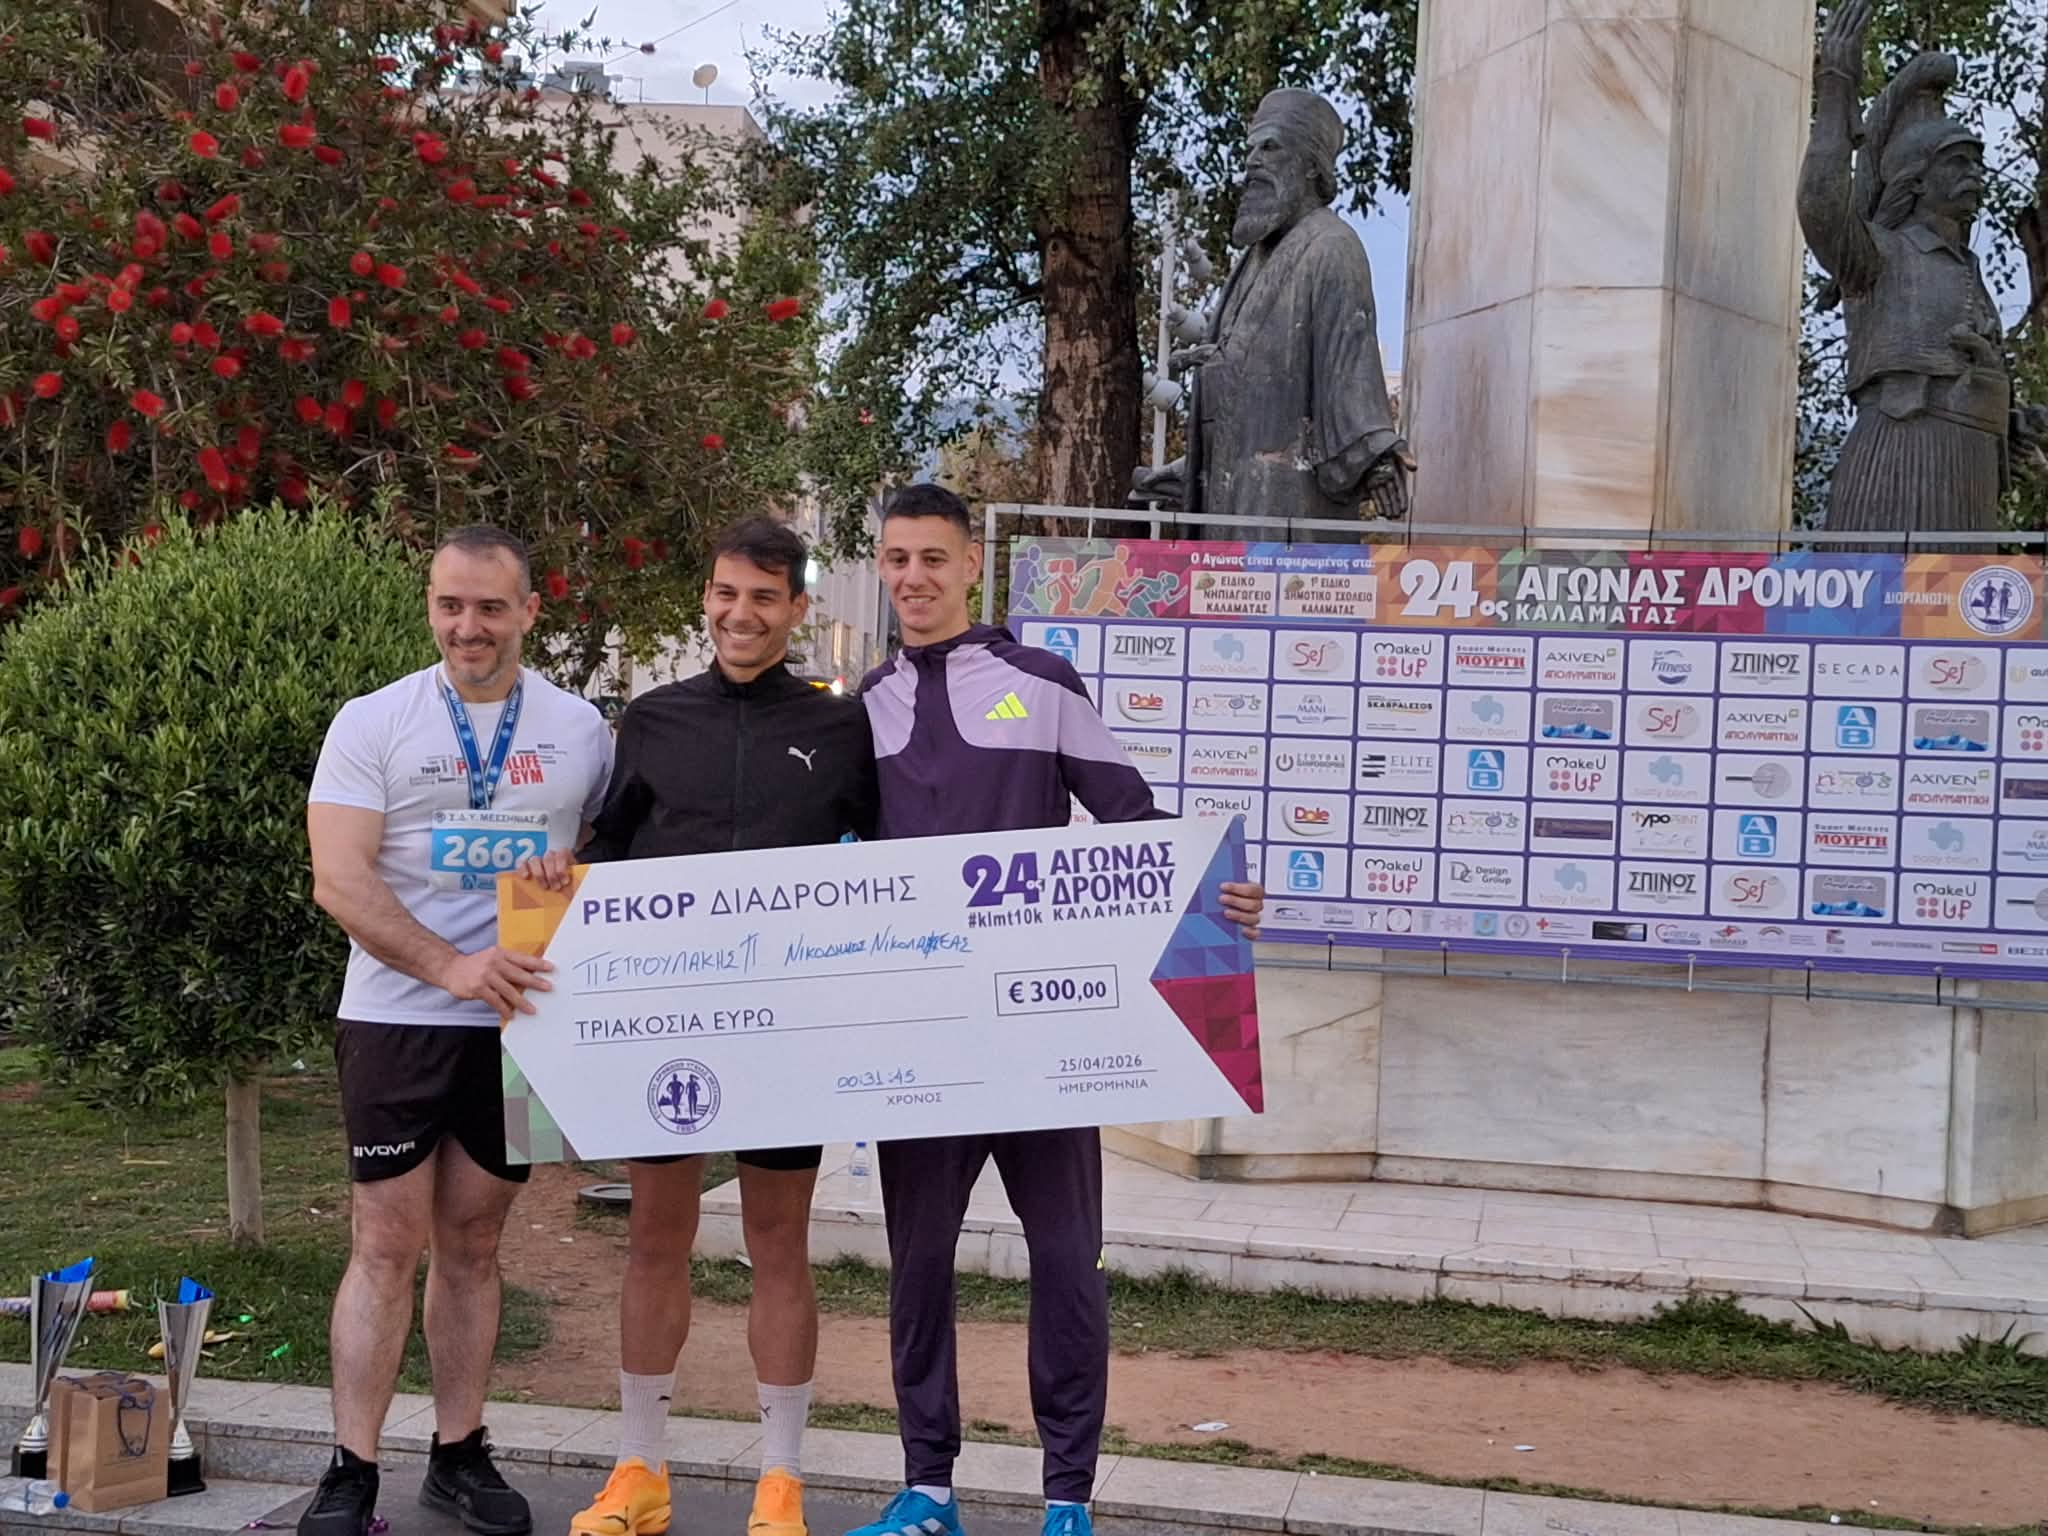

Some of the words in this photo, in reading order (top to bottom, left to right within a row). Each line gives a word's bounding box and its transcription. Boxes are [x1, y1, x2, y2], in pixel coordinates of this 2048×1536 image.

[1203, 553, 1244, 568] Αγώνας
[1276, 555, 1350, 570] αφιερωμένος
[1221, 576, 1255, 586] ΕΙΔΙΚΟ
[1516, 566, 1685, 604] ΑΓΩΝΑΣ
[1697, 567, 1874, 609] ΔΡΟΜΟΥ
[1206, 604, 1268, 614] ΚΑΛΑΜΑΤΑΣ
[1301, 604, 1355, 615] ΚΑΛΑΜΑΤΑΣ
[1516, 604, 1677, 624] ΚΑΛΑΜΑΤΑΣ
[1112, 635, 1177, 656] ΣΠΙΝΟΣ
[1456, 655, 1526, 668] ΜΟΥΡΓΗ
[1546, 652, 1606, 663] AXIVEN
[1729, 652, 1800, 674] ΣΠΙΝΟΣ
[1818, 662, 1899, 676] SECADA
[1128, 693, 1163, 708] Dole
[1726, 712, 1787, 723] AXIVEN
[1192, 749, 1247, 760] AXIVEN
[1390, 755, 1433, 768] ELITE
[510, 769, 545, 785] GYM
[1910, 773, 1977, 786] AXIVEN
[1294, 806, 1330, 823] Dole
[1363, 805, 1429, 827] ΣΠΙΝΟΣ
[1814, 833, 1888, 847] ΜΟΥΡΓΗ
[442, 835, 537, 869] 2662
[1049, 841, 1176, 877] ΑΓΩΝΑΣ
[1475, 866, 1508, 876] Design
[1052, 869, 1176, 904] ΔΡΟΜΟΥ
[1482, 876, 1511, 885] Group
[1628, 871, 1696, 894] ΣΠΙΝΟΣ
[583, 892, 696, 925] ΡΕΚΟΡ
[710, 874, 917, 916] ΔΙΑΔΡΟΜΗΣ
[1053, 901, 1174, 922] ΚΑΛΑΜΑΤΑΣ
[1030, 978, 1107, 1003] 300,00
[575, 1013, 704, 1041] ΤΡΙΑΚΟΣΙΑ
[713, 1007, 775, 1031] ΕΥΡΩ
[1058, 1054, 1143, 1072] 25/04/2026
[1058, 1077, 1149, 1095] ΗΜΕΡΟΜΗΝΙΑ
[886, 1092, 942, 1106] ΧΡΟΝΟΣ
